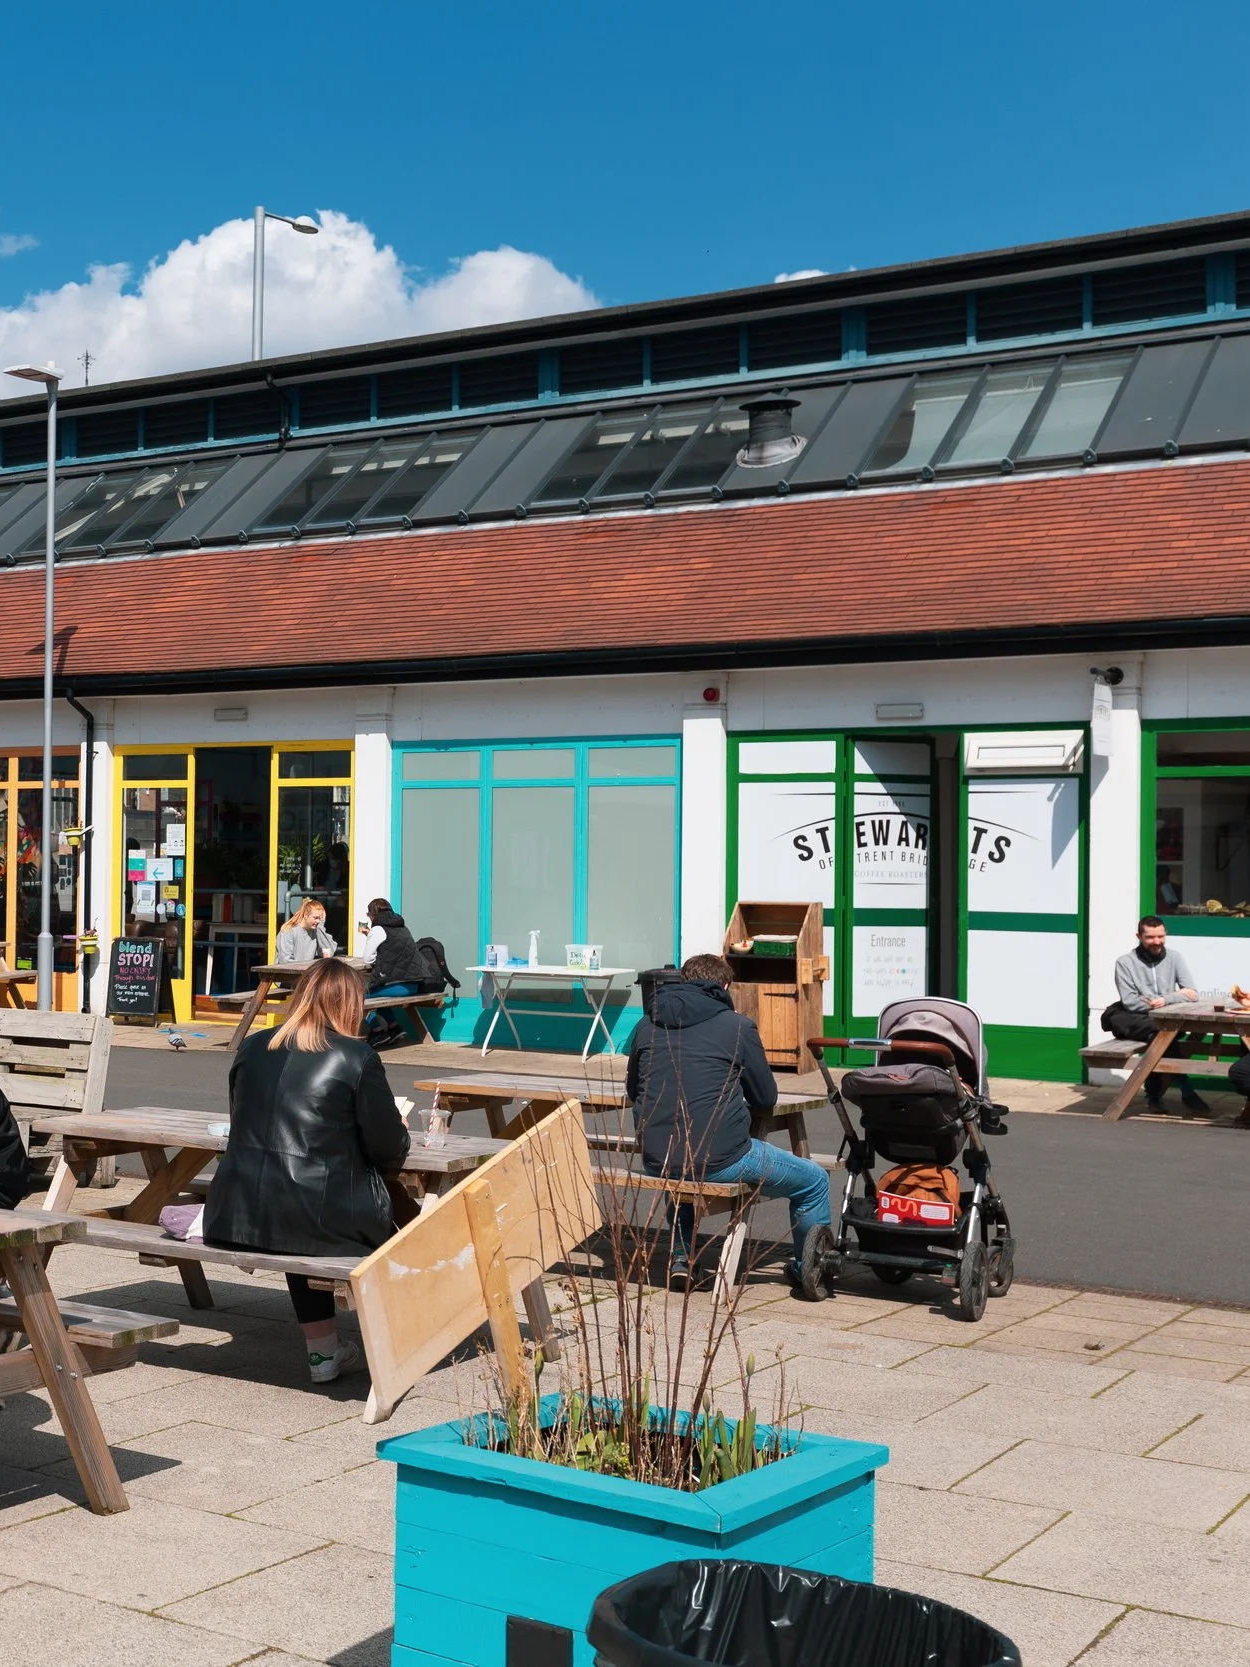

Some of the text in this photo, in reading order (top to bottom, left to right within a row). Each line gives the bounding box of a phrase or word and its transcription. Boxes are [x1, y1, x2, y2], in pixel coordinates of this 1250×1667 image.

[793, 819, 1012, 864] STEWARTS
[819, 857, 834, 870] OF
[857, 851, 894, 863] TRENT
[118, 941, 153, 953] blend
[871, 934, 906, 947] Entrance
[118, 953, 155, 967] STOP!
